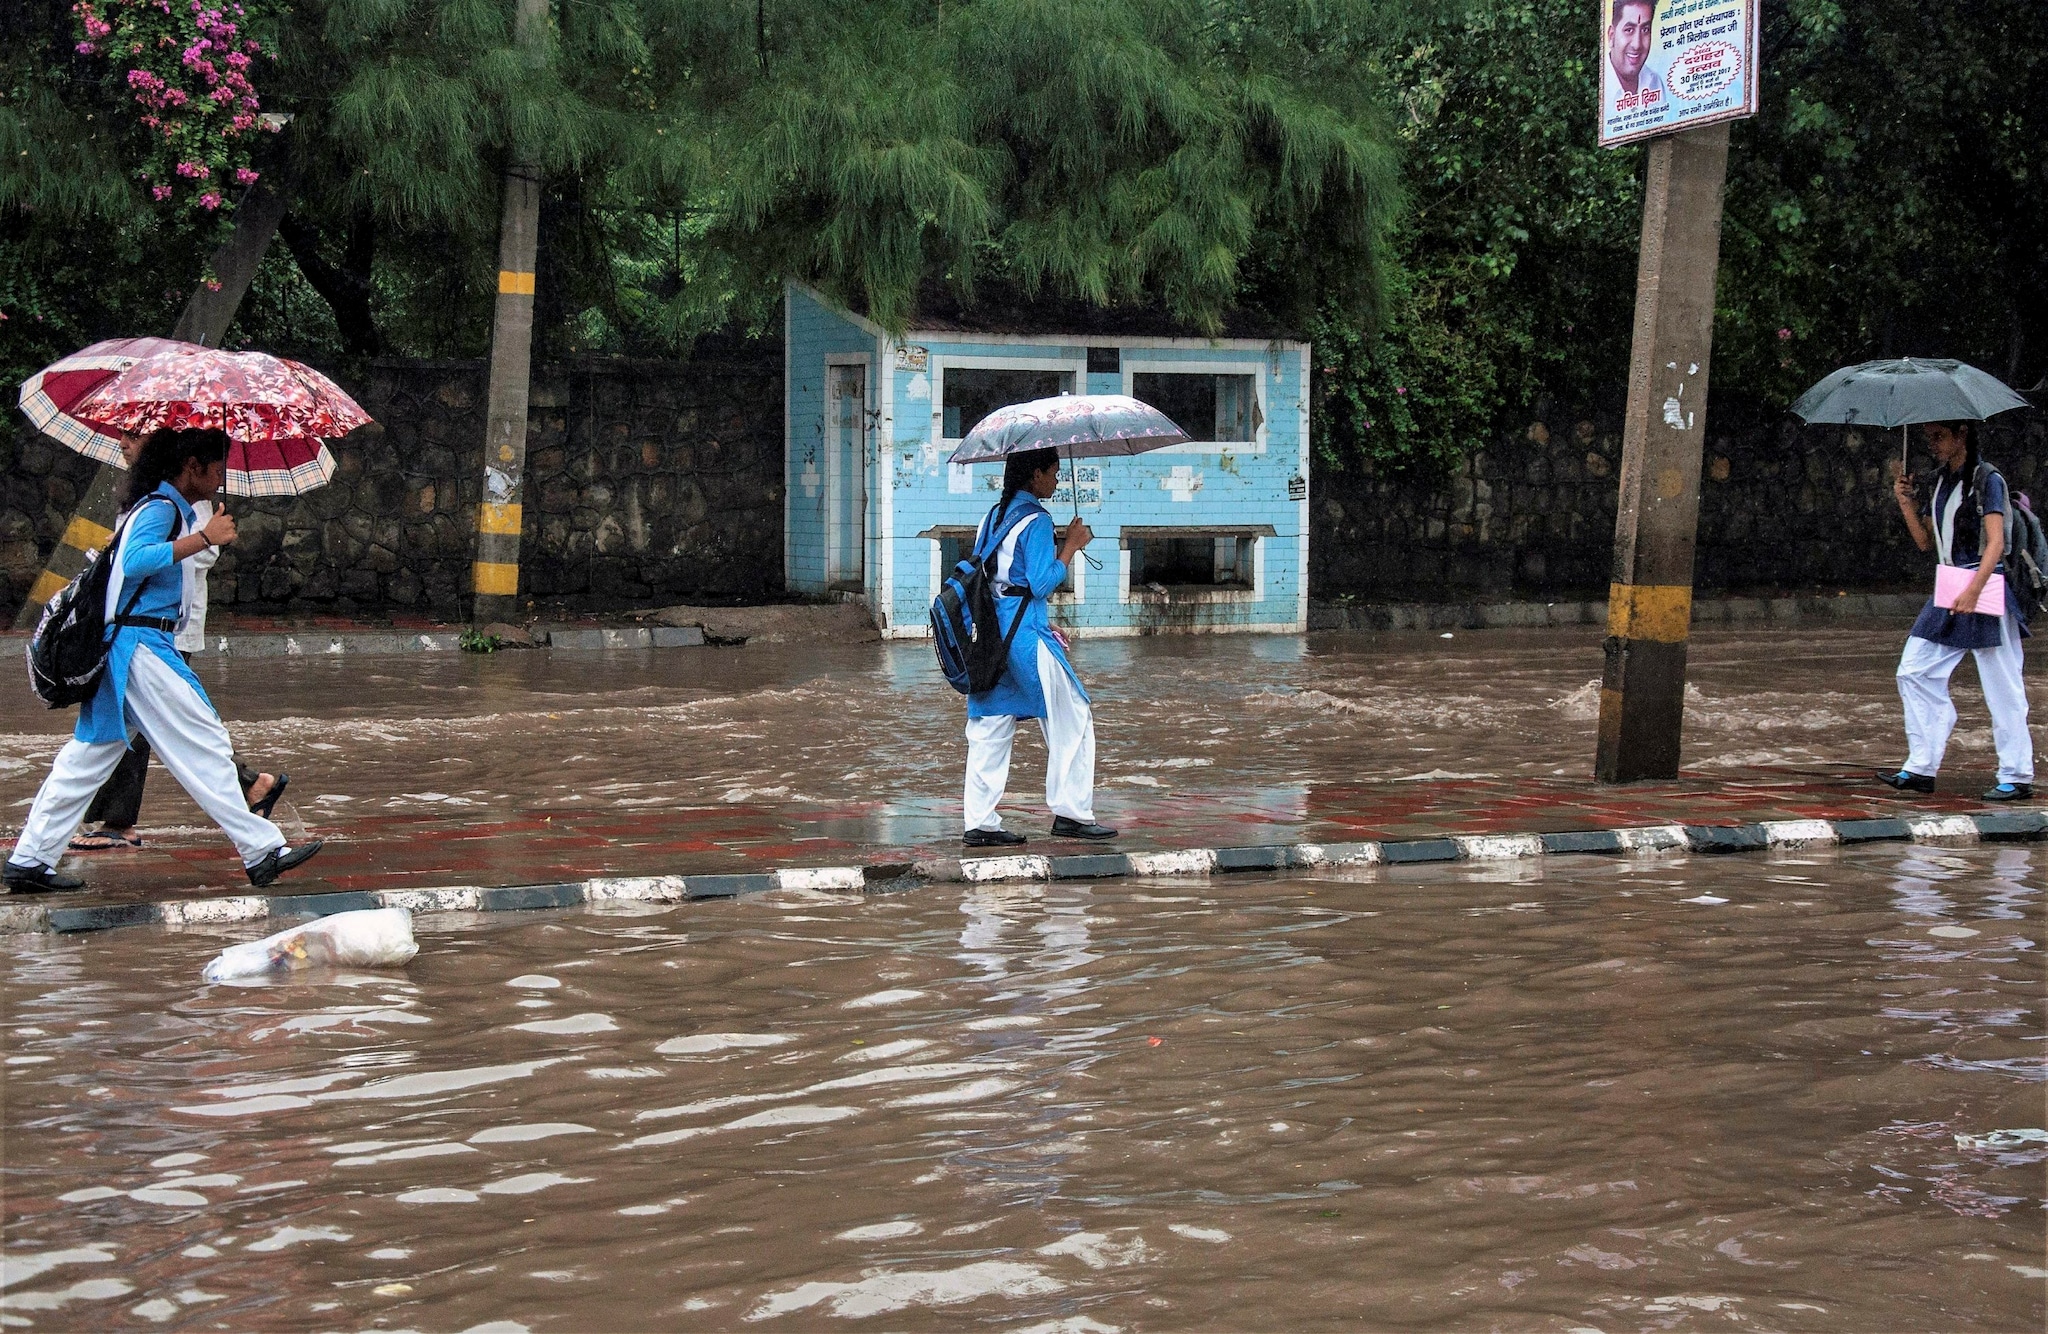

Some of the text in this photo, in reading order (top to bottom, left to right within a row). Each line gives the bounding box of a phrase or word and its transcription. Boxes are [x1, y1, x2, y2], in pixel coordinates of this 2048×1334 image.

[1660, 26, 1677, 39] प्रेरणा
[1694, 15, 1706, 28] एवं
[1663, 19, 1739, 50] स्व. श्री त्रिलोक चन्द जी
[1684, 49, 1725, 65] दशहरा
[1681, 75, 1690, 84] 30
[1719, 67, 1731, 75] 2017
[1687, 60, 1722, 75] उत्सव
[1616, 93, 1640, 112] सचिन
[1691, 103, 1702, 114] सभी
